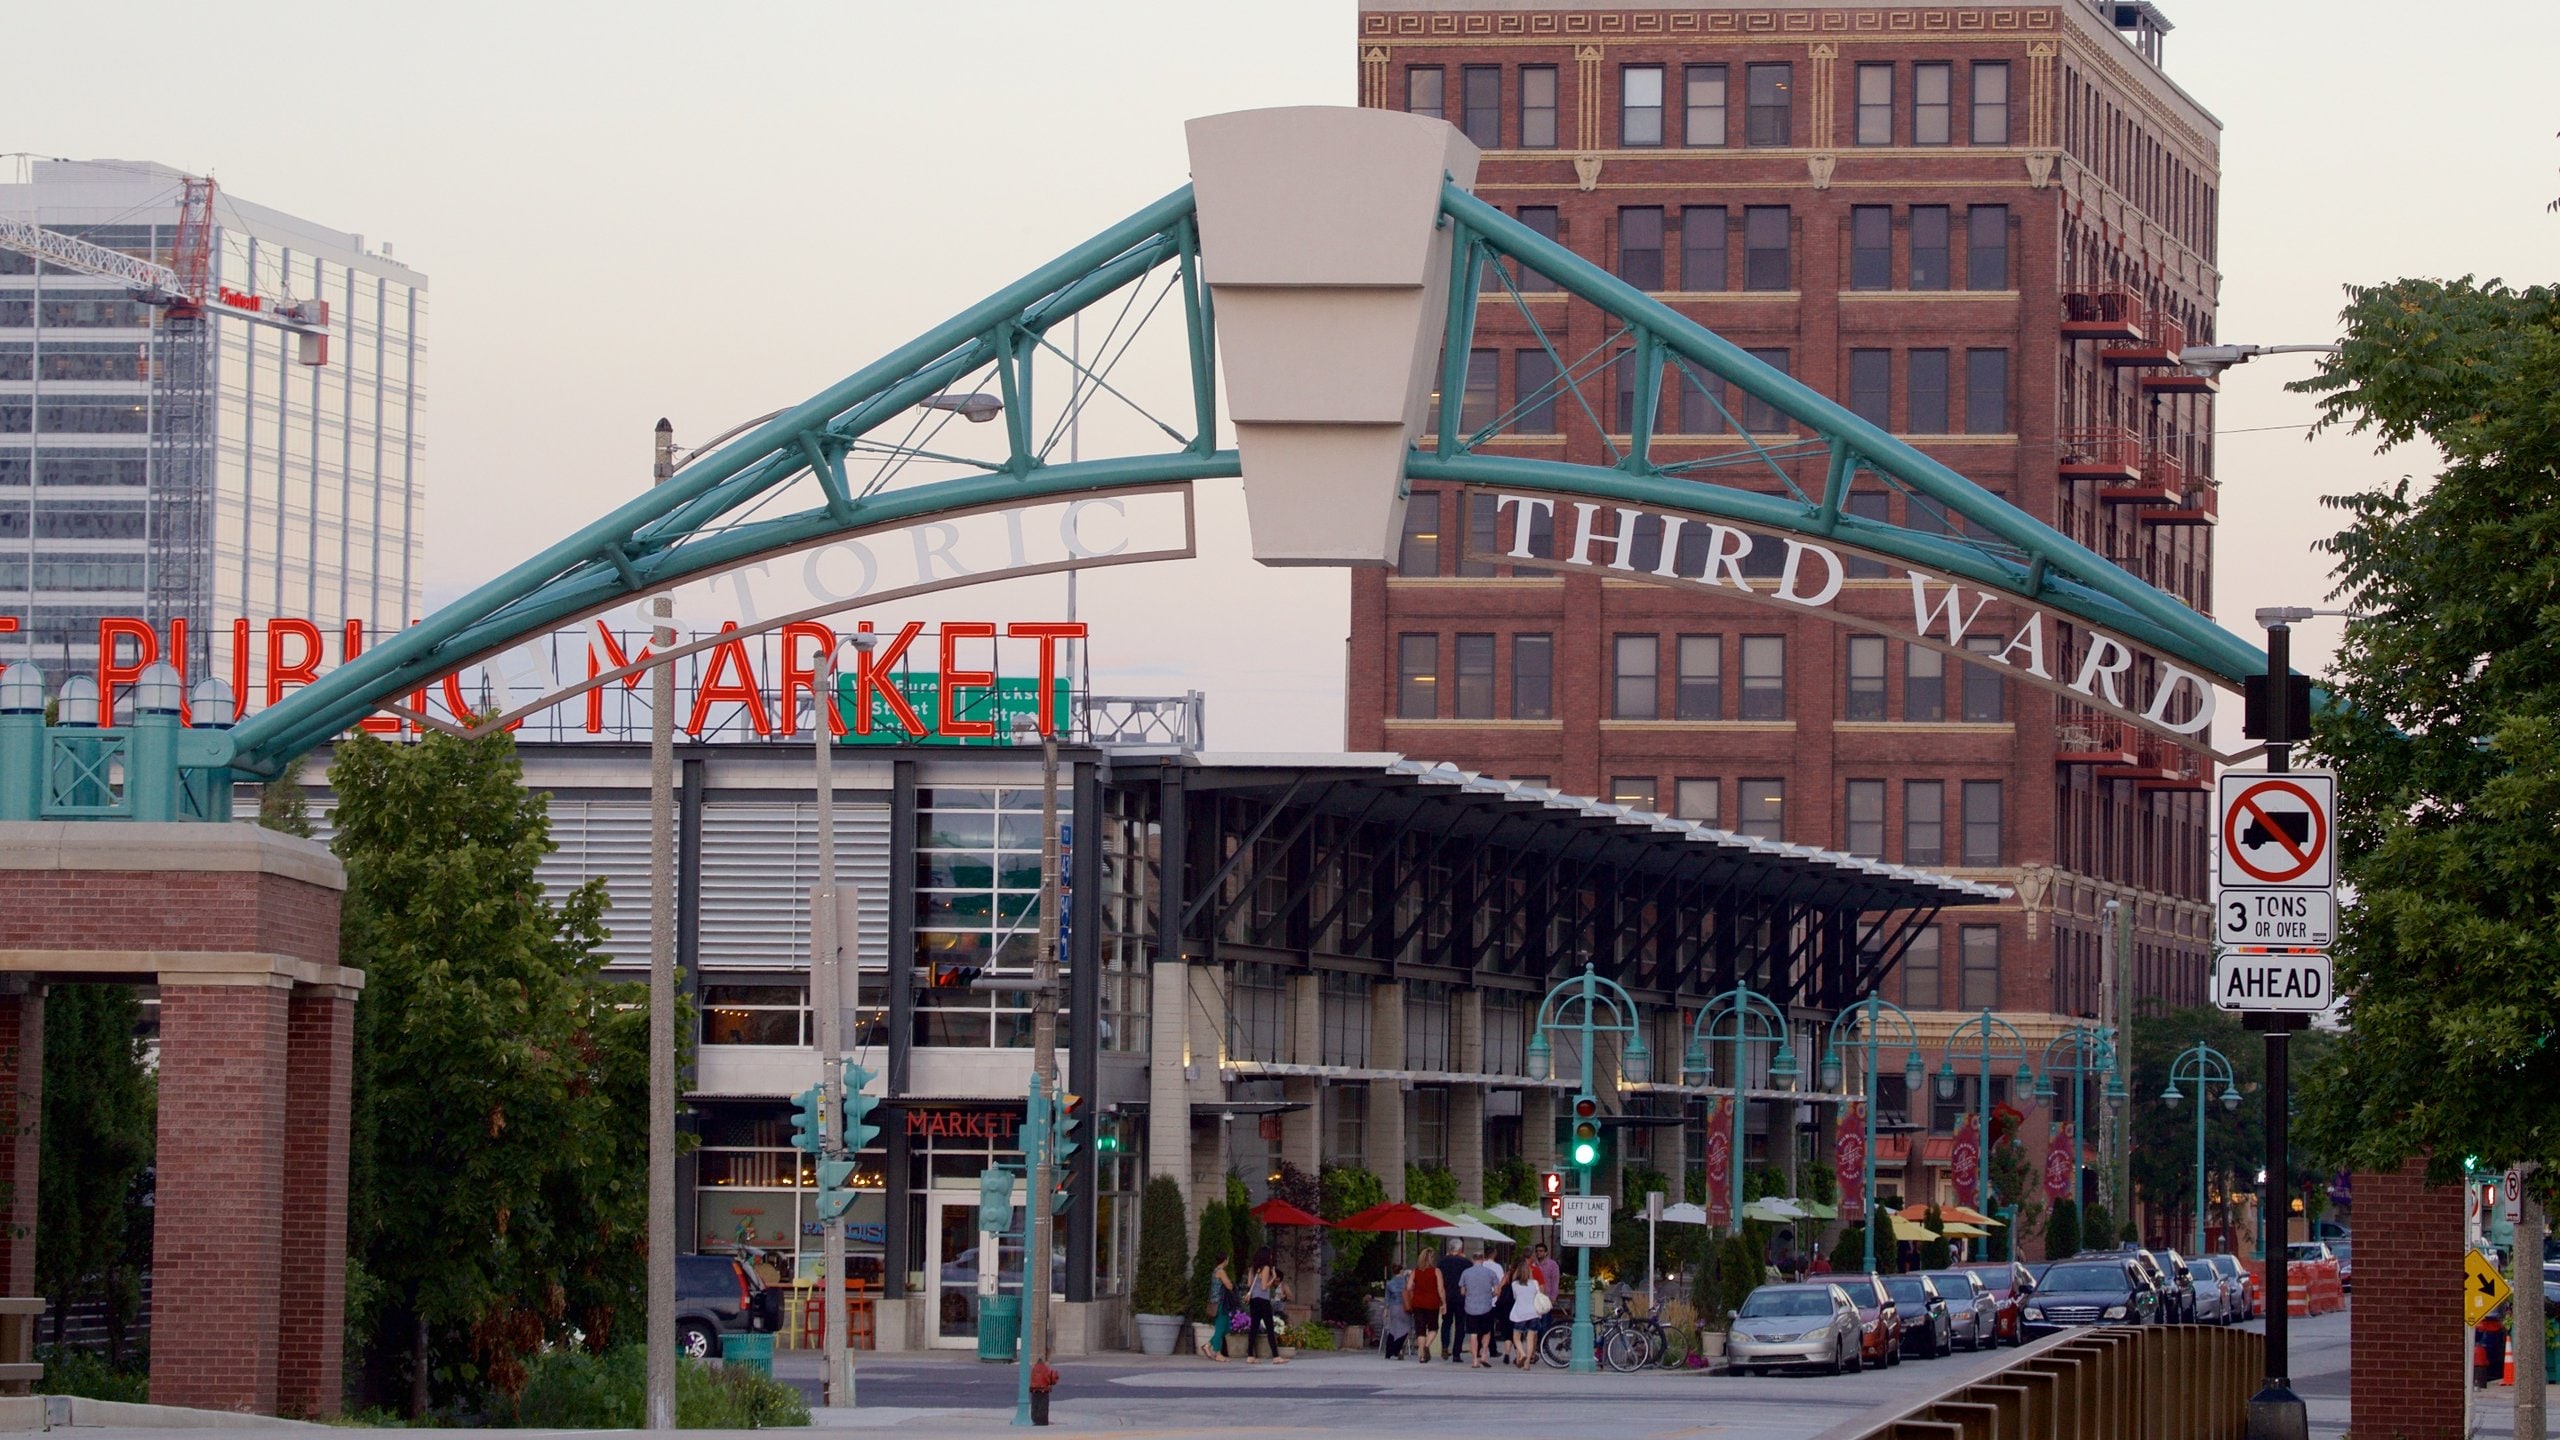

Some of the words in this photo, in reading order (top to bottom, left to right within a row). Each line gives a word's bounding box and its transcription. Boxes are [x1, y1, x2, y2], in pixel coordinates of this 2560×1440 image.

[1497, 495, 1844, 607] THIRD
[1907, 570, 2217, 735] WARD
[586, 620, 1089, 738] MARKET
[2227, 902, 2247, 932] 3
[2255, 896, 2307, 917] TONS
[2255, 922, 2270, 937] OR
[2277, 922, 2307, 937] OVER
[2227, 967, 2321, 998] AHEAD
[906, 1111, 1017, 1138] MARKET
[1551, 1198, 1561, 1216] 2
[1567, 1202, 1584, 1210] LEFT
[1587, 1202, 1605, 1211] LANE
[1576, 1216, 1598, 1225] MUST
[1567, 1230, 1584, 1238] TURN
[1588, 1231, 1605, 1239] LEFT
